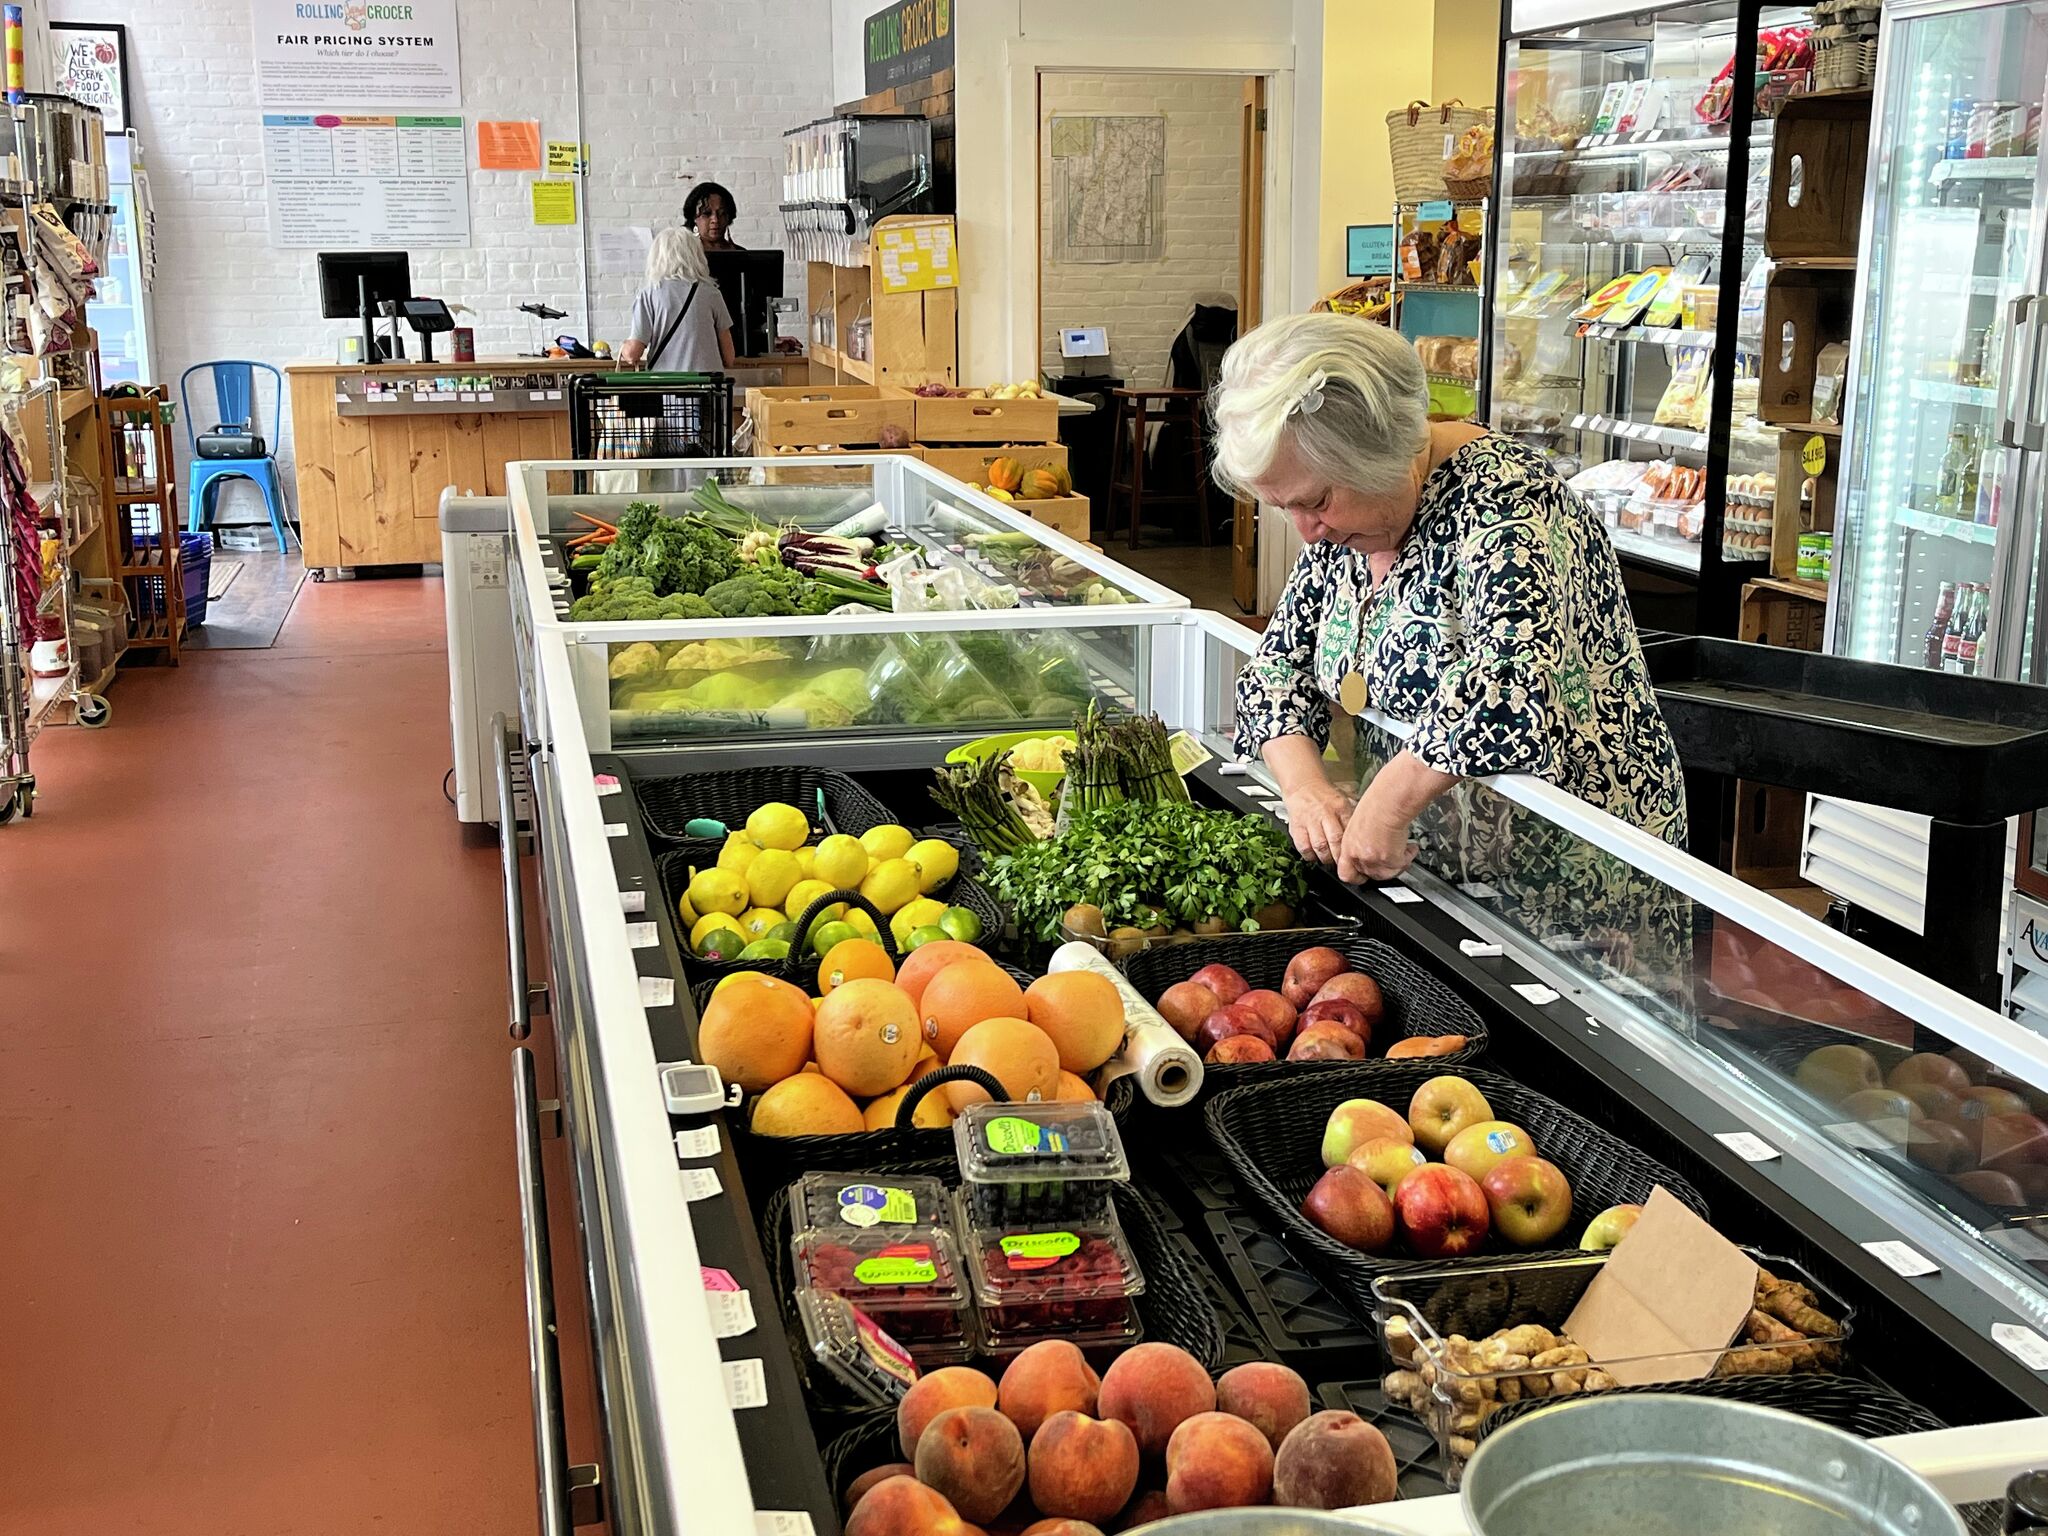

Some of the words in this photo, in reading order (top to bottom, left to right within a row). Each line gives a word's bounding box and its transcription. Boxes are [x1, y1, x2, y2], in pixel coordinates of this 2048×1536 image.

[296, 3, 344, 19] ROLLING
[367, 5, 413, 20] GROCER
[870, 13, 900, 64] ROLLING
[902, 0, 934, 53] GROCER
[277, 35, 309, 45] FAIR
[314, 35, 373, 46] PRICING
[378, 36, 434, 47] SYSTEM
[70, 43, 88, 57] WE
[317, 49, 340, 57] Which
[355, 49, 365, 57] do
[371, 49, 399, 58] choose?
[70, 56, 90, 68] ALL
[68, 68, 104, 81] DESERVE
[75, 81, 100, 92] FOOD
[559, 145, 577, 153] Accept
